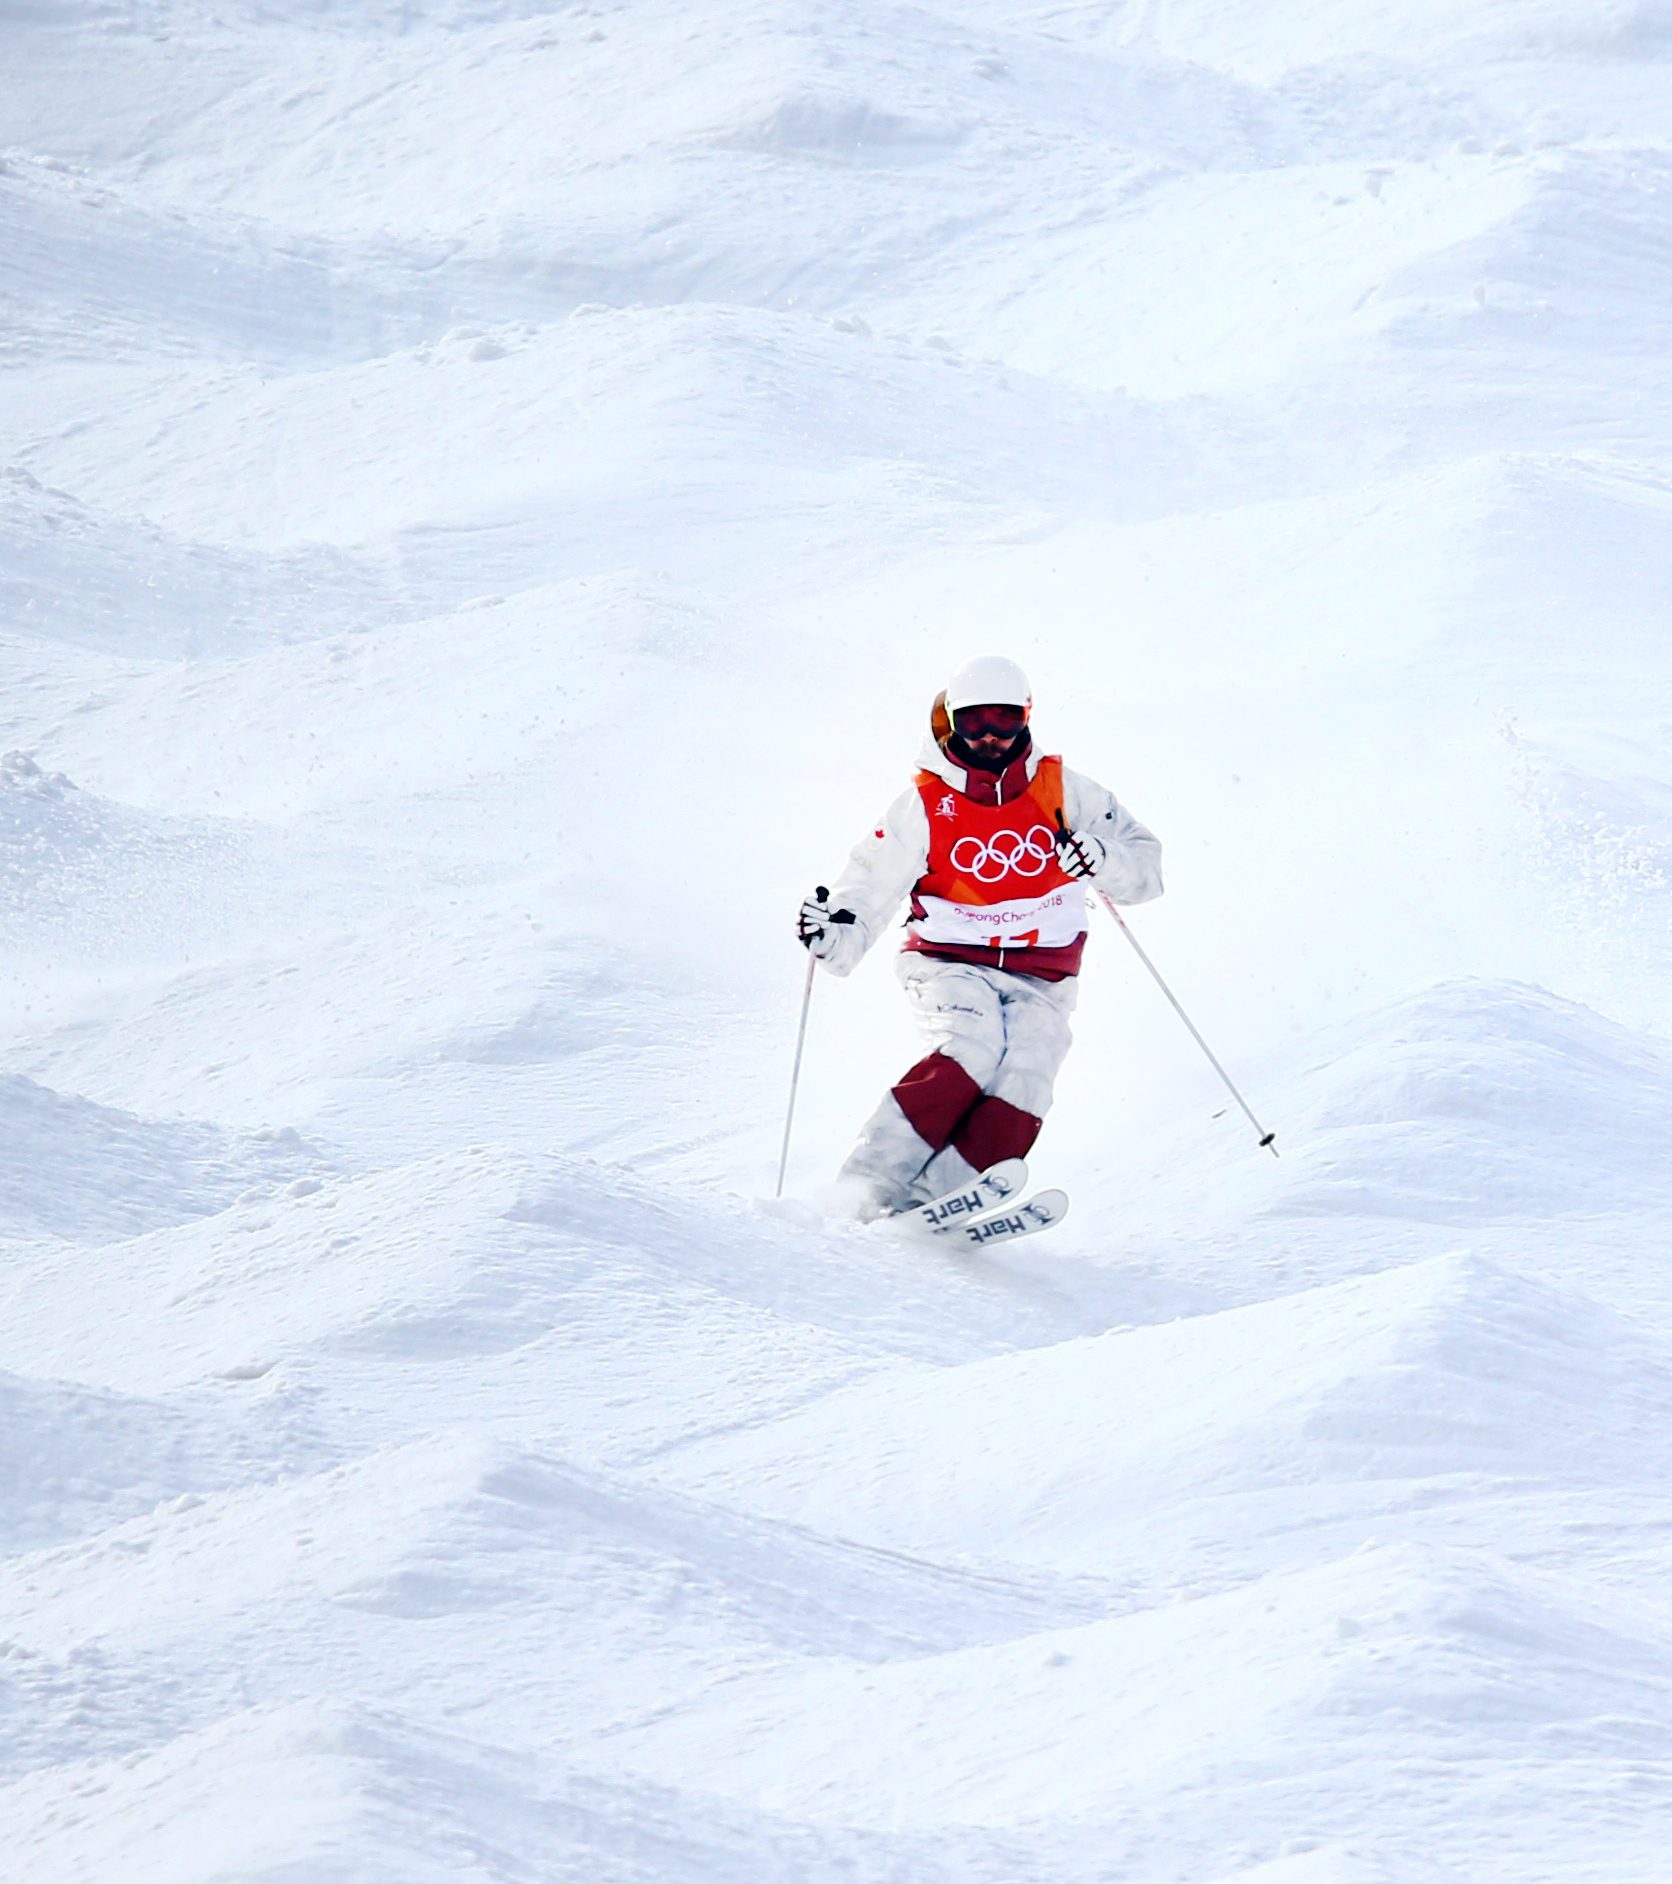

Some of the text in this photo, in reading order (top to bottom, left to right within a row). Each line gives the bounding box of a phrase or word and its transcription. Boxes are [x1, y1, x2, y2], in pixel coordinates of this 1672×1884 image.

[1037, 894, 1063, 911] 018
[922, 1190, 984, 1225] Hart
[966, 1215, 1026, 1243] Hart
